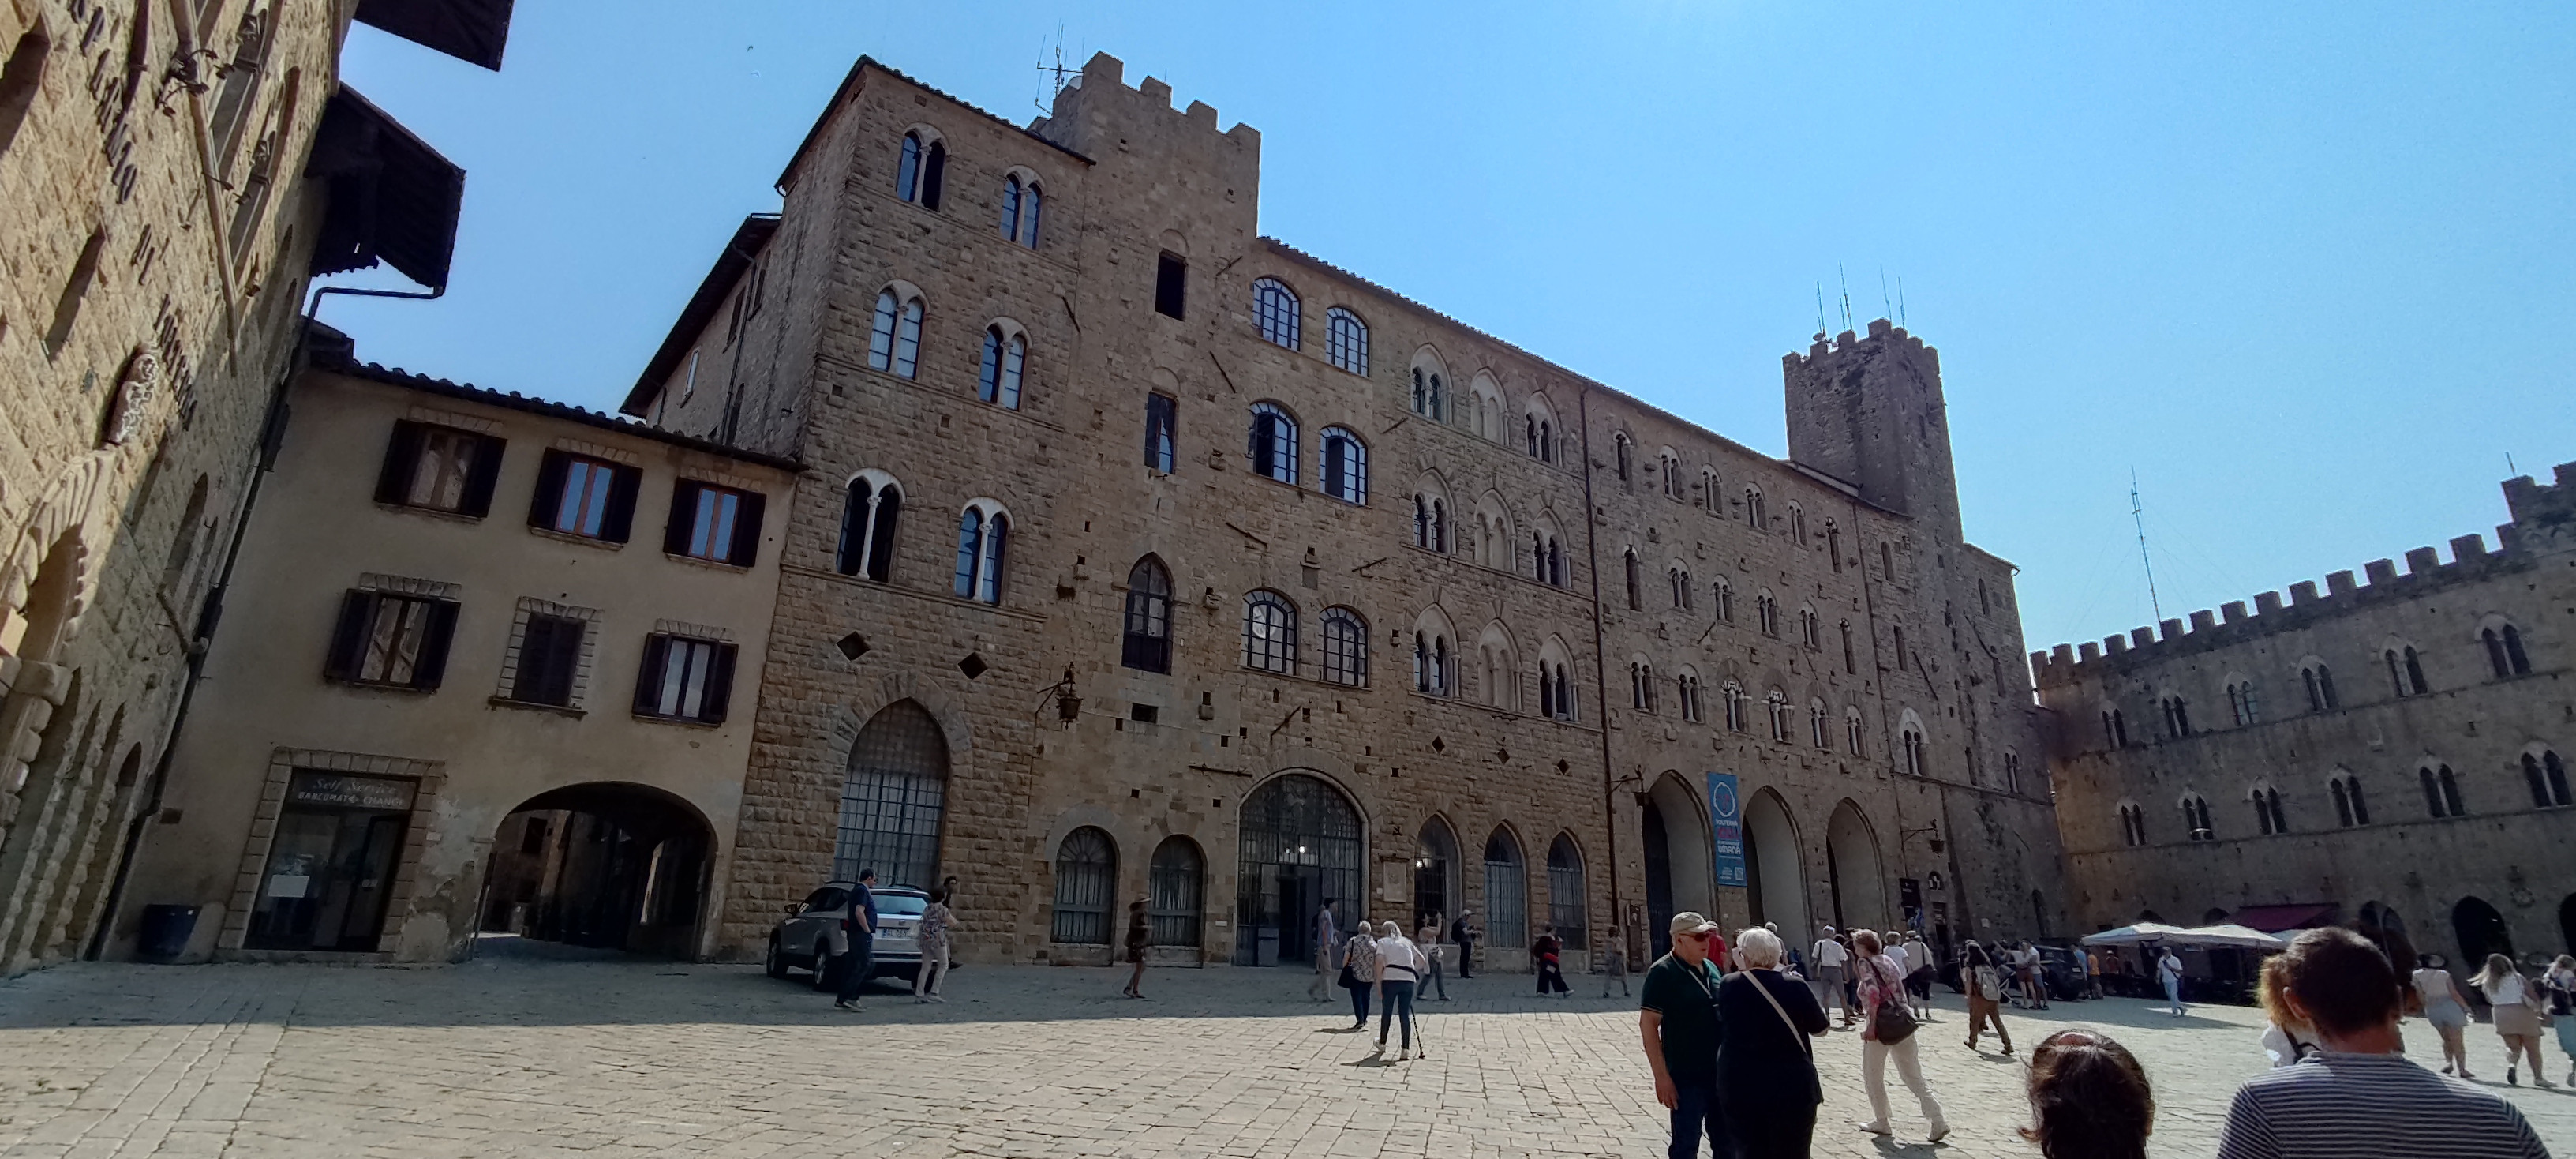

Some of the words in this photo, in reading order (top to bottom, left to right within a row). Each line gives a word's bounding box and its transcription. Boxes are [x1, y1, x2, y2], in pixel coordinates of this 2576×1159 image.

[313, 778, 342, 791] Self
[347, 781, 396, 794] Service
[363, 796, 404, 806] CHANGE
